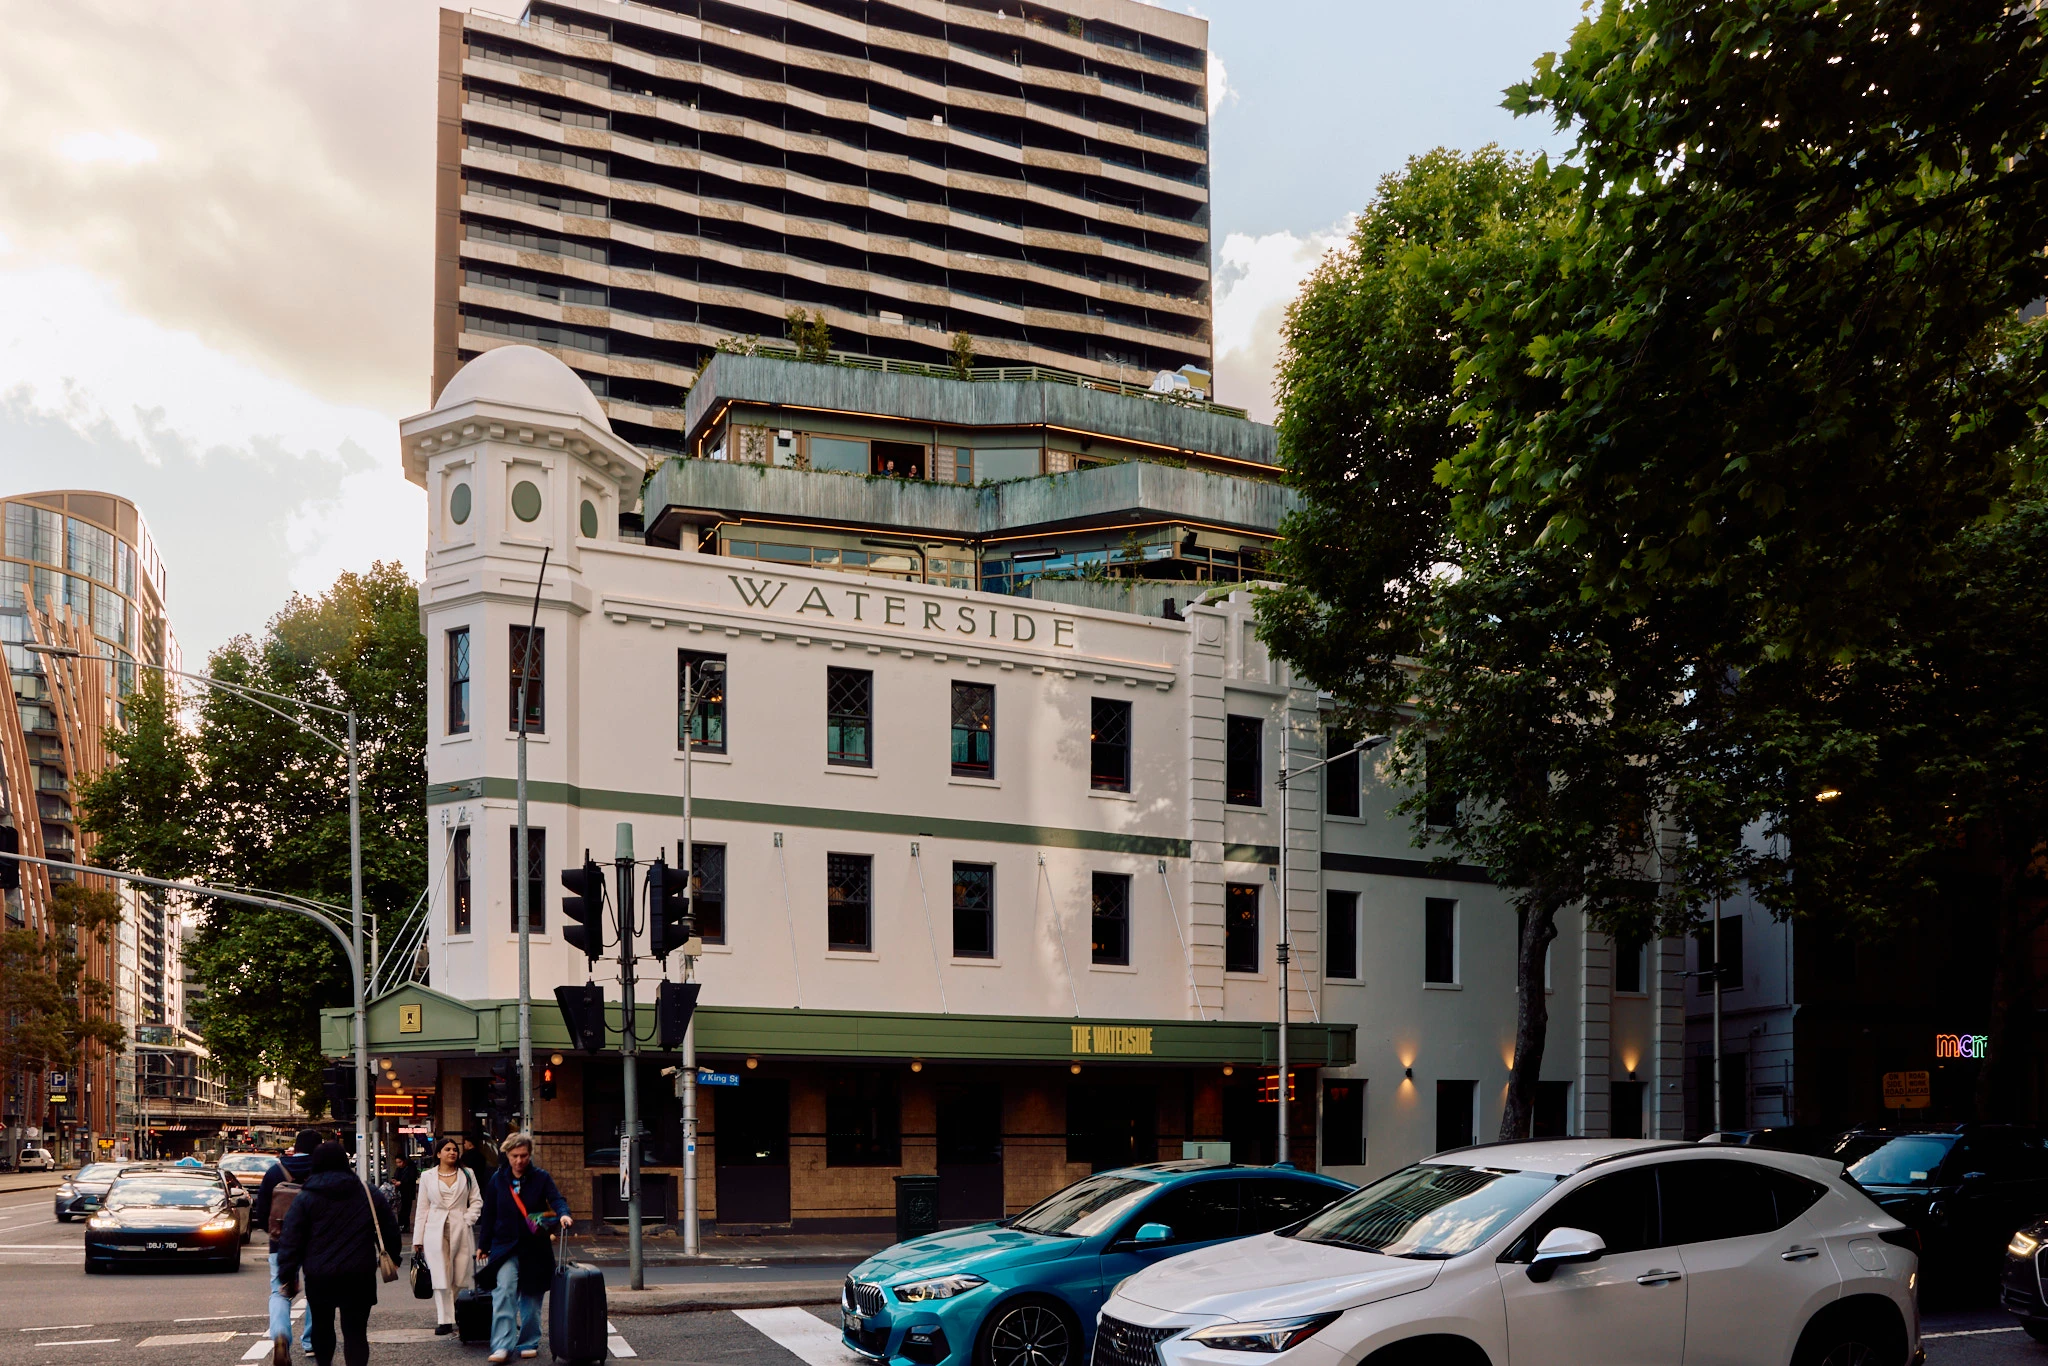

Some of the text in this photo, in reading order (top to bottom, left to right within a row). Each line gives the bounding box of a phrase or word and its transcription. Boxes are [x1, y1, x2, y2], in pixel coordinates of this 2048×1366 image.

[728, 575, 1074, 648] WATERSIDE
[1071, 1026, 1153, 1054] THE WATERSIDE
[54, 1074, 63, 1084] P
[708, 1074, 738, 1083] King St
